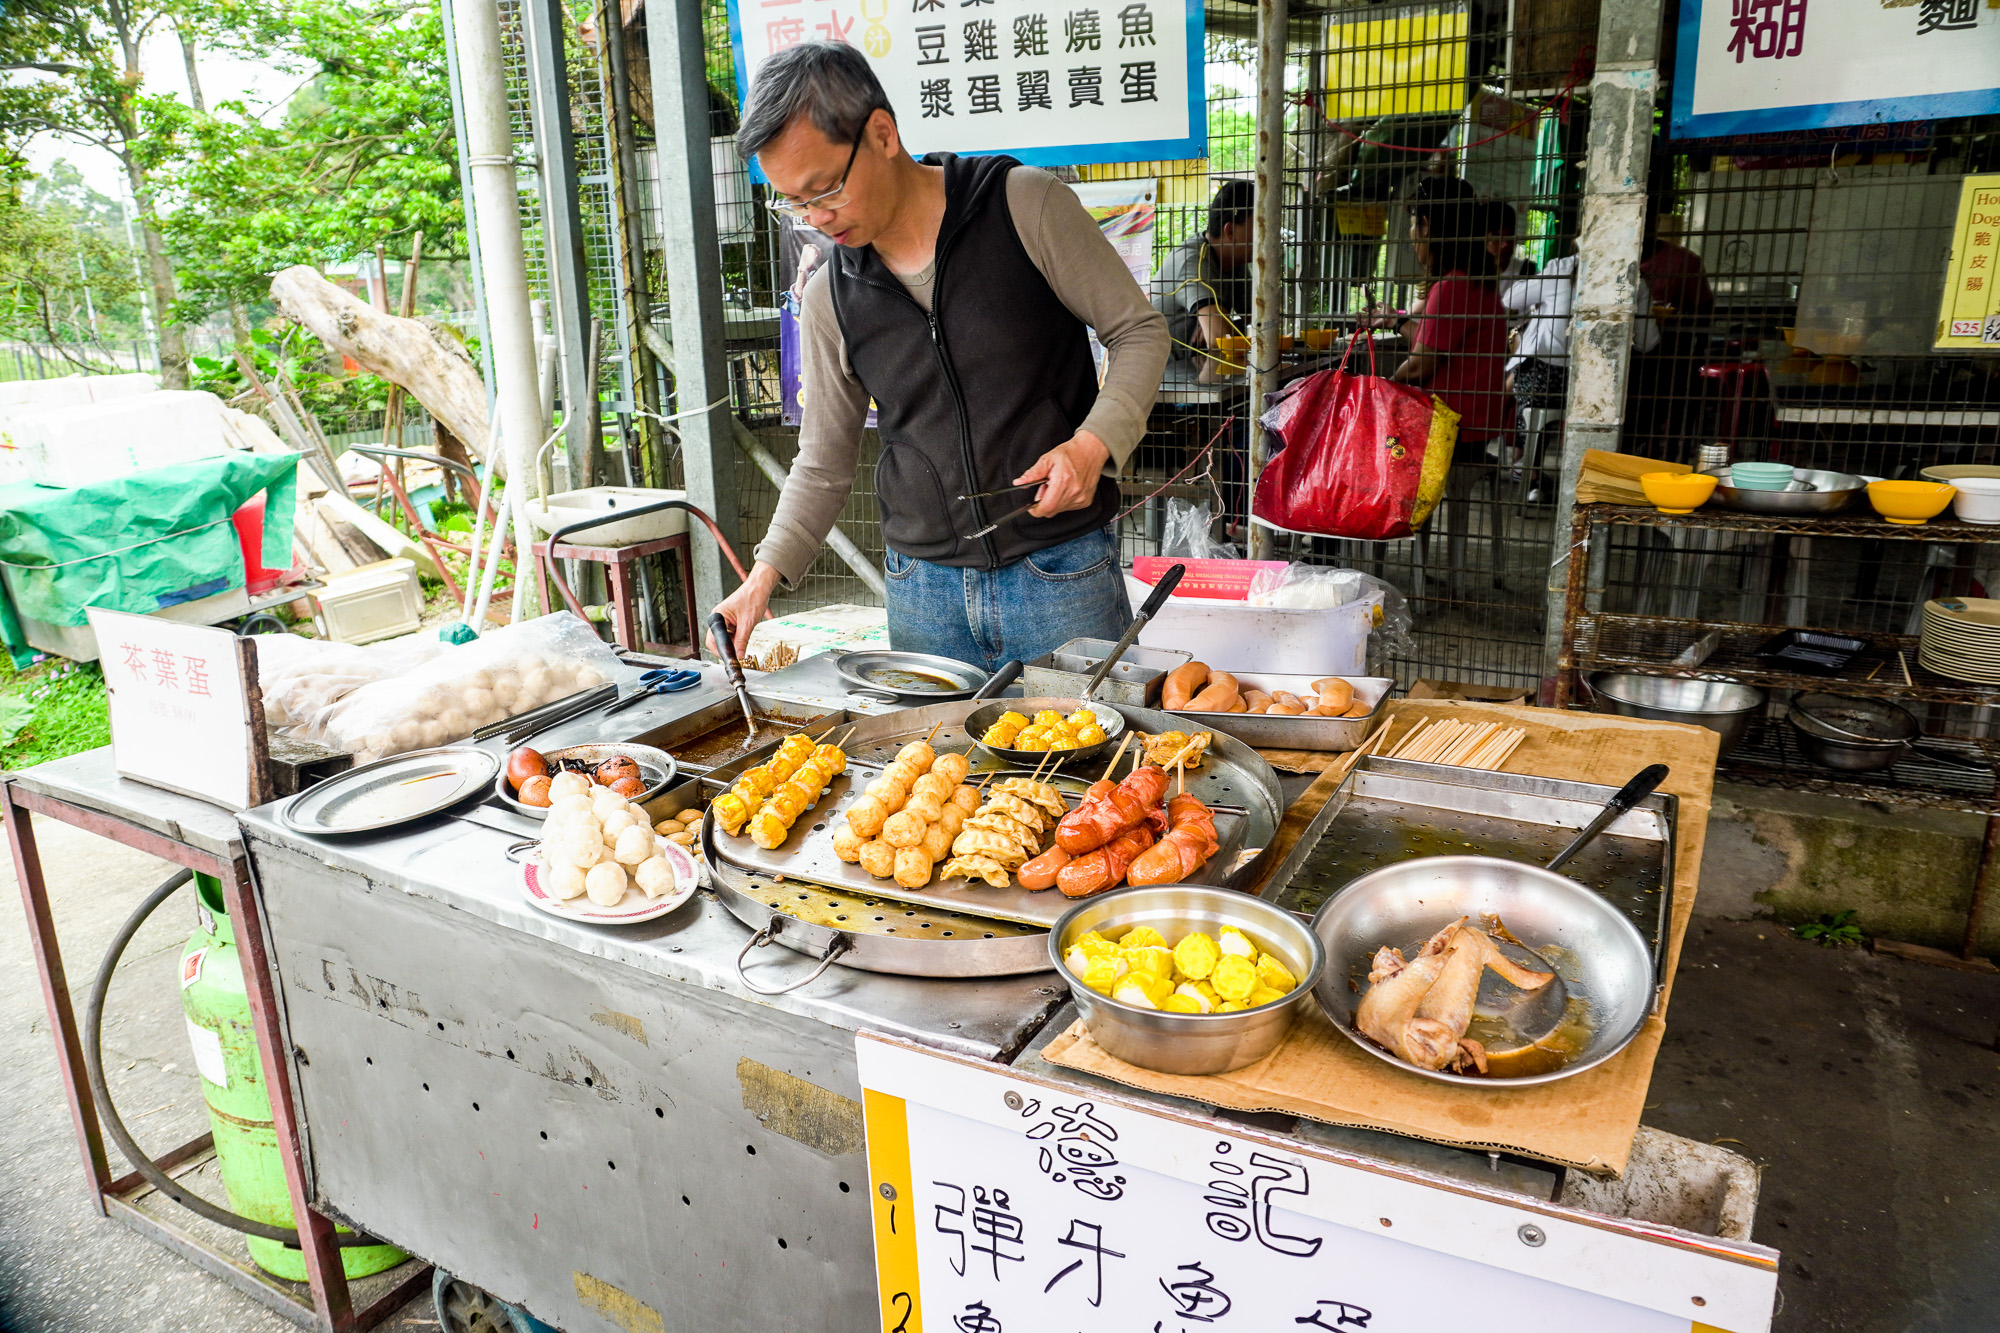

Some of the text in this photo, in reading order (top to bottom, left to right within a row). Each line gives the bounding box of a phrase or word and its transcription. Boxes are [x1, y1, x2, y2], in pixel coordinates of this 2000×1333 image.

[912, 0, 955, 118] 豆漿
[960, 0, 1003, 115] 雞蛋
[1013, 13, 1052, 112] 雞翼
[1064, 8, 1104, 108] 燒賣
[1117, 2, 1158, 103] 魚蛋
[1953, 322, 1980, 334] $25
[119, 641, 213, 699] 茶葉蛋
